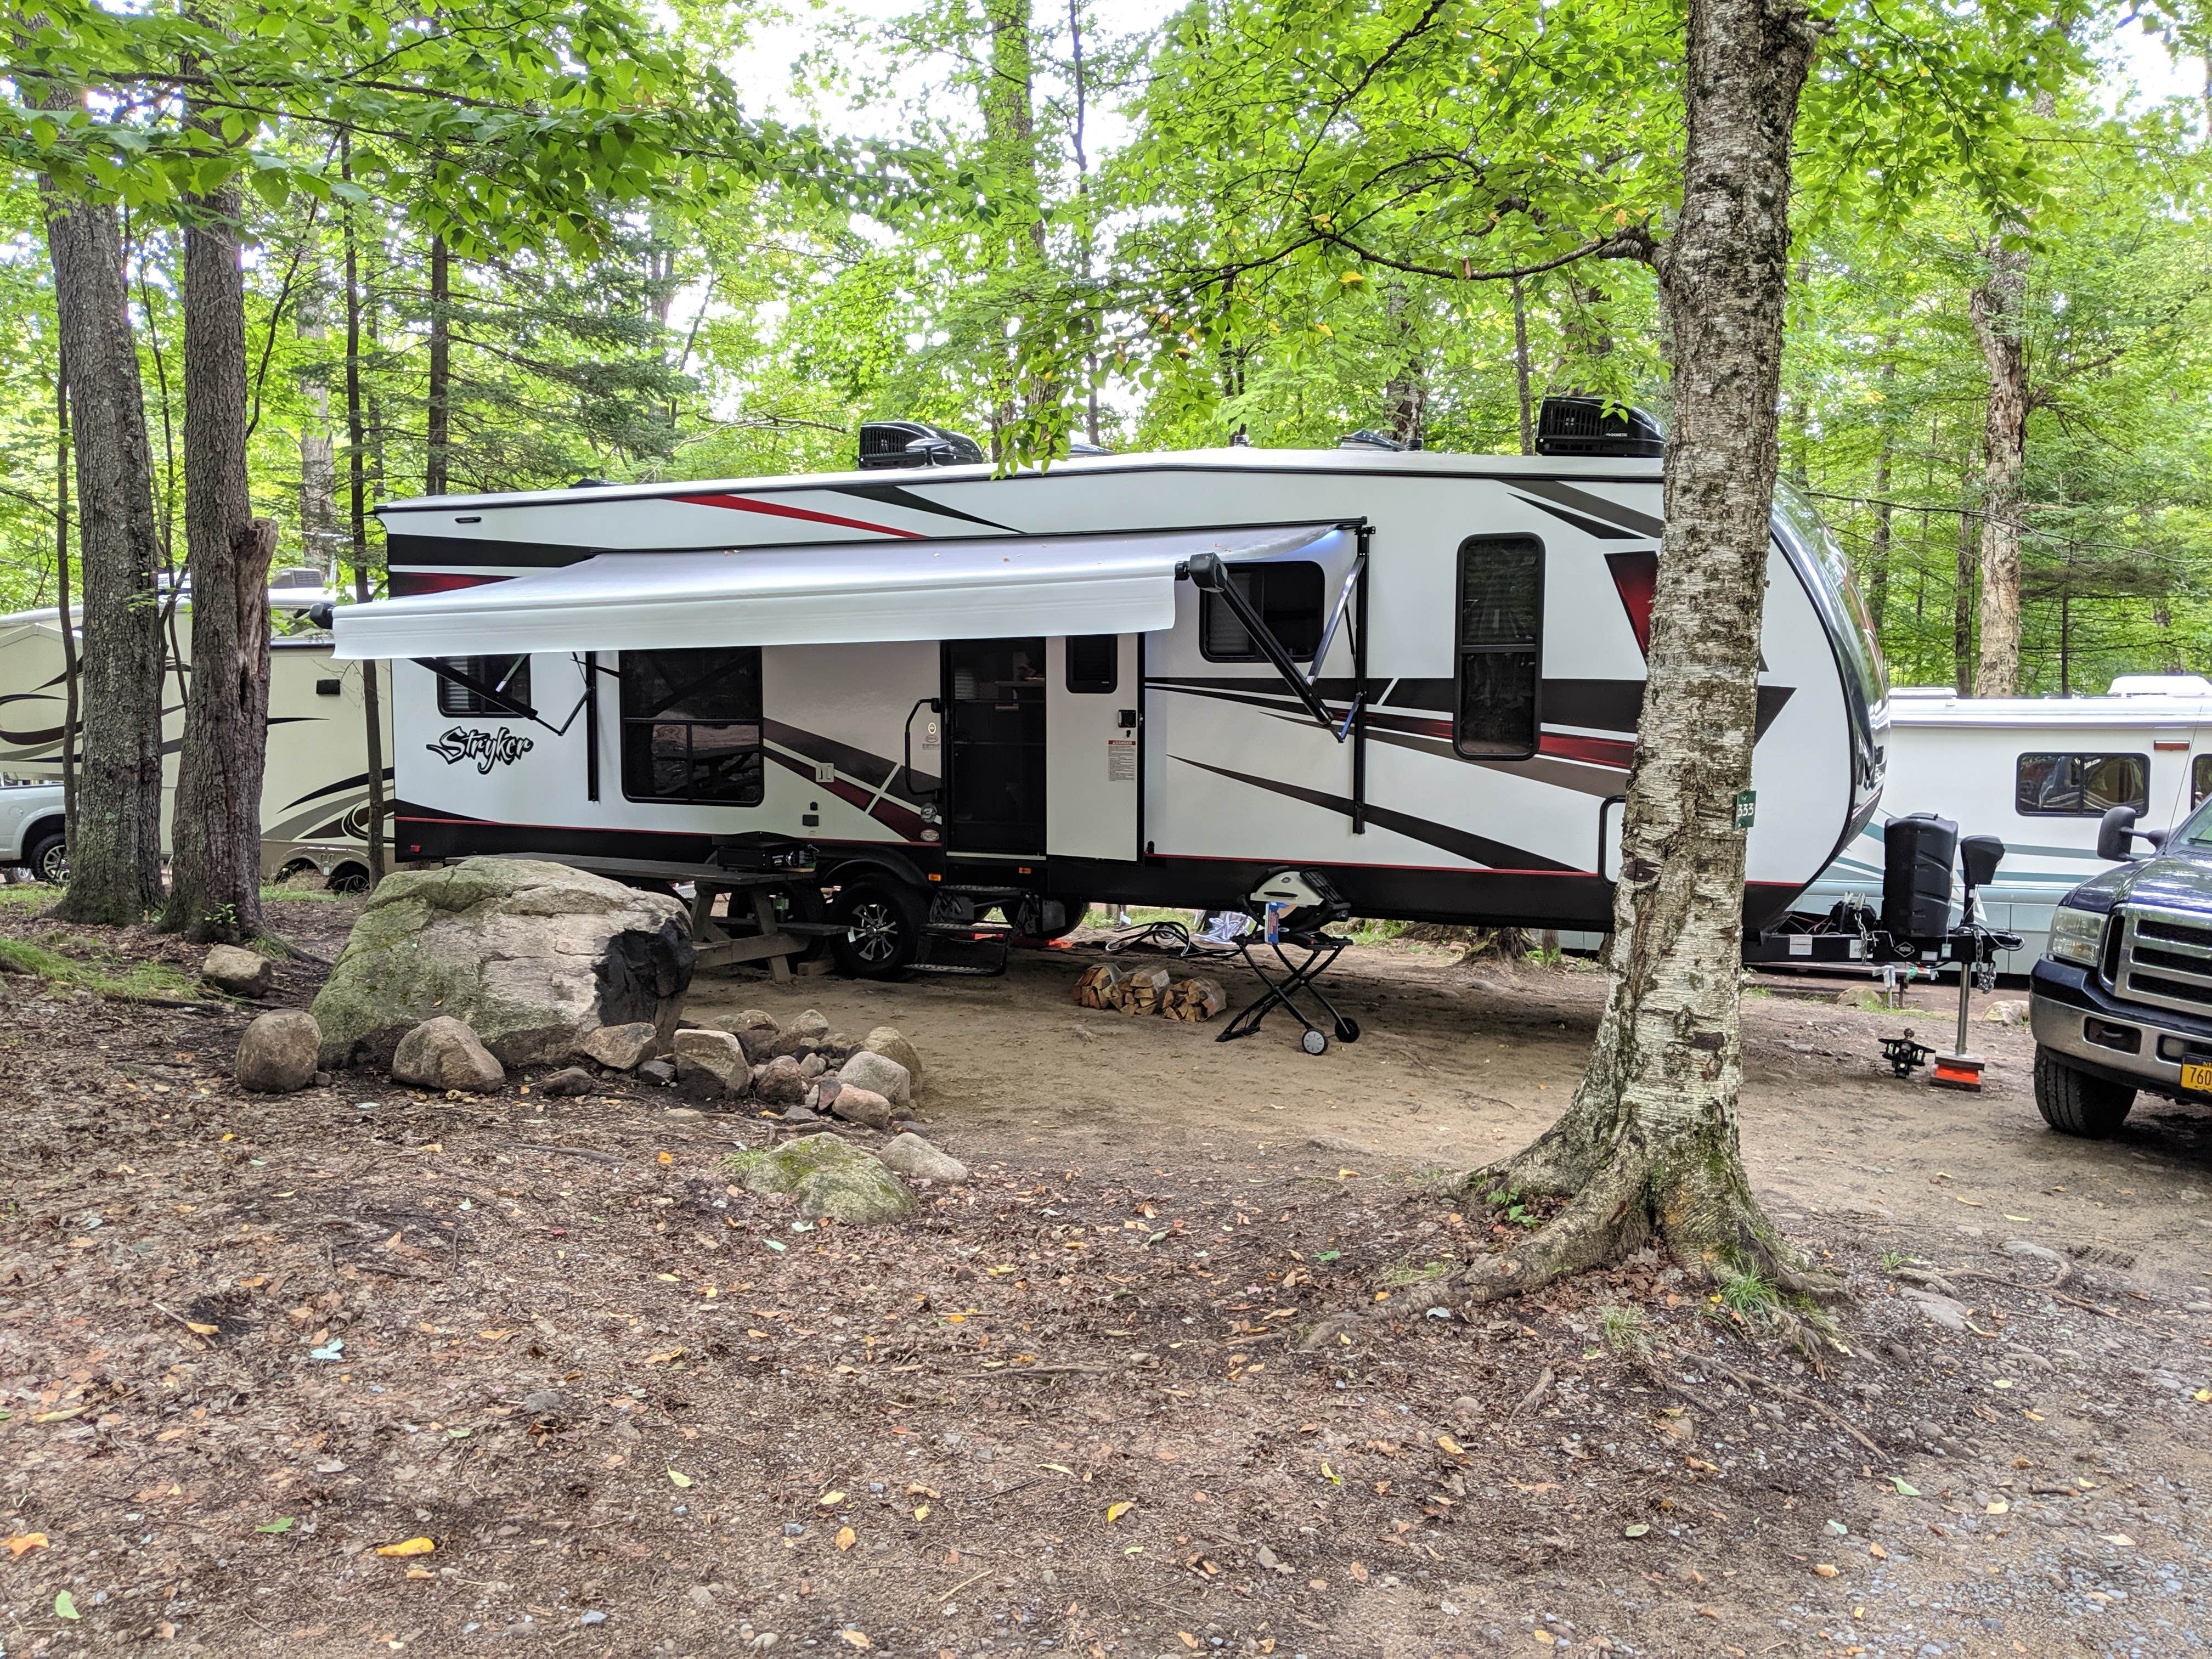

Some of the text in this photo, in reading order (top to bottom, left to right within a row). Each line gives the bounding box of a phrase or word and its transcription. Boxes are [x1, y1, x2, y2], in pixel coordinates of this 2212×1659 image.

[426, 725, 534, 775] Stryker
[1737, 803, 1754, 817] 333
[2190, 1066, 2211, 1086] 760
